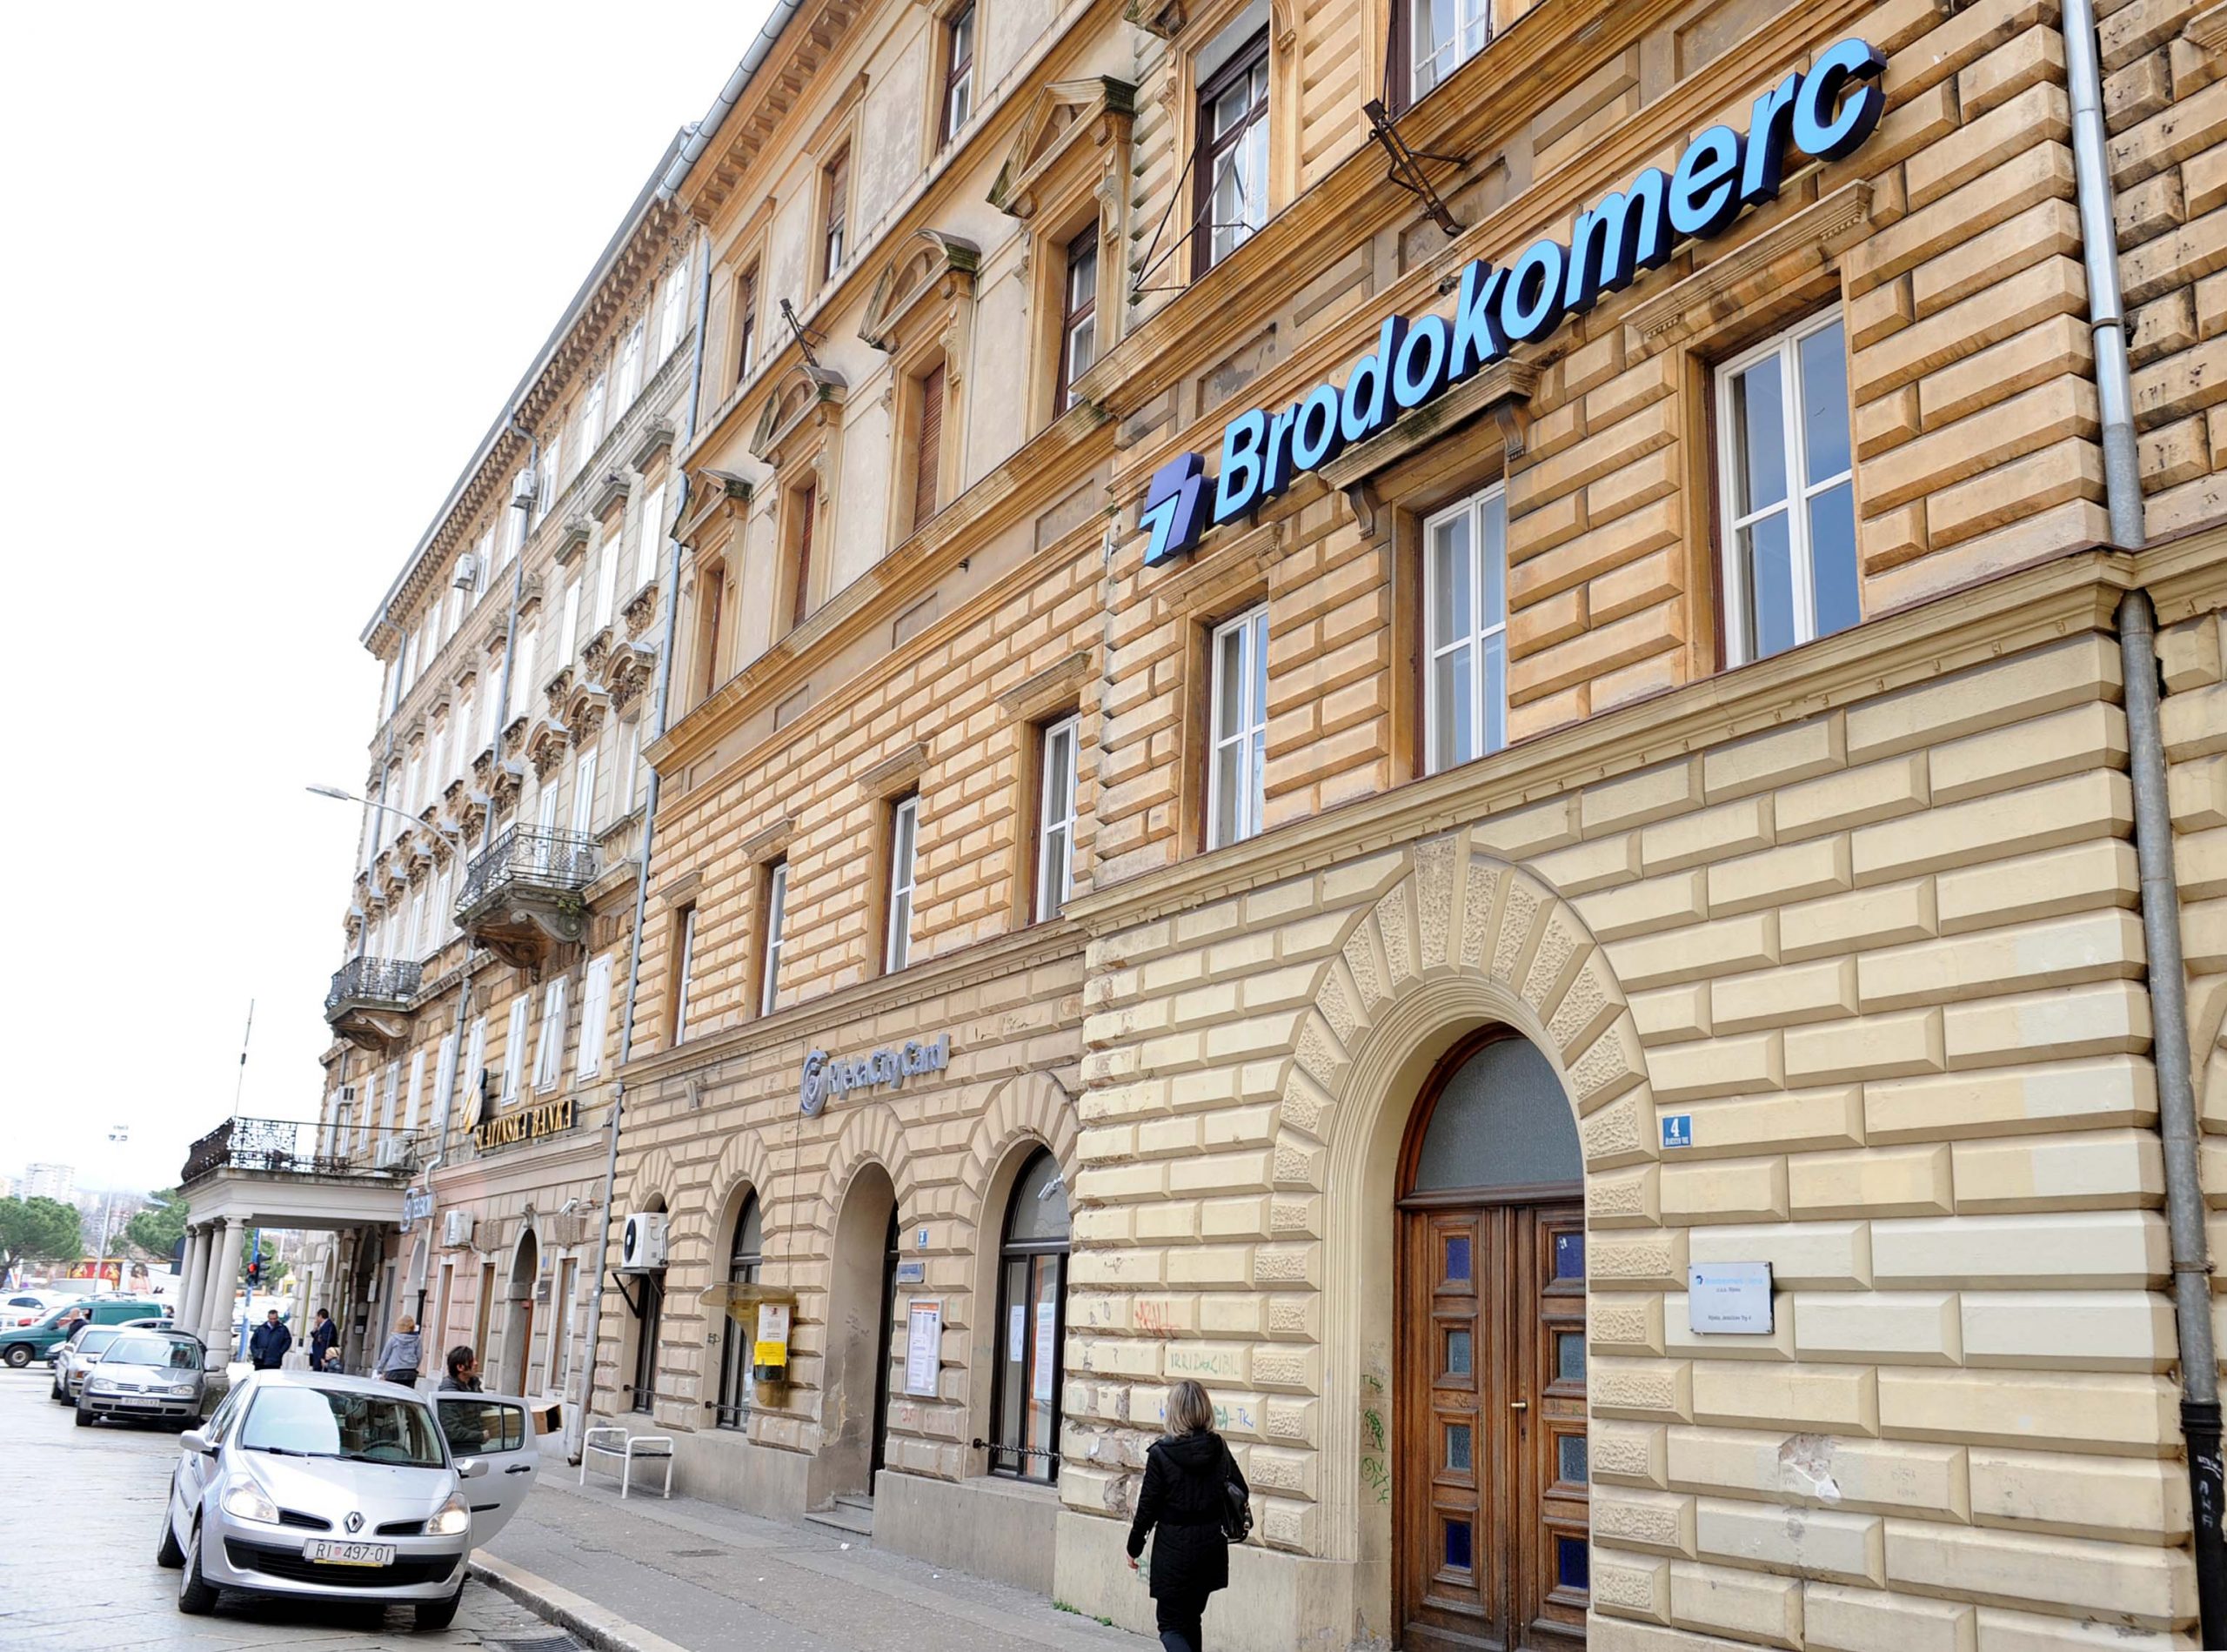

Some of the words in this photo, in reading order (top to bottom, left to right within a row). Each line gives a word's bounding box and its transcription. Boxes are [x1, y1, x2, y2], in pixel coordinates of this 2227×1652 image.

[1214, 37, 1887, 525] Brodokomerc
[474, 1113, 532, 1152] SLATINSKA
[532, 1100, 577, 1138] BANKA
[1670, 1118, 1680, 1137] 4
[316, 1543, 332, 1557] RI
